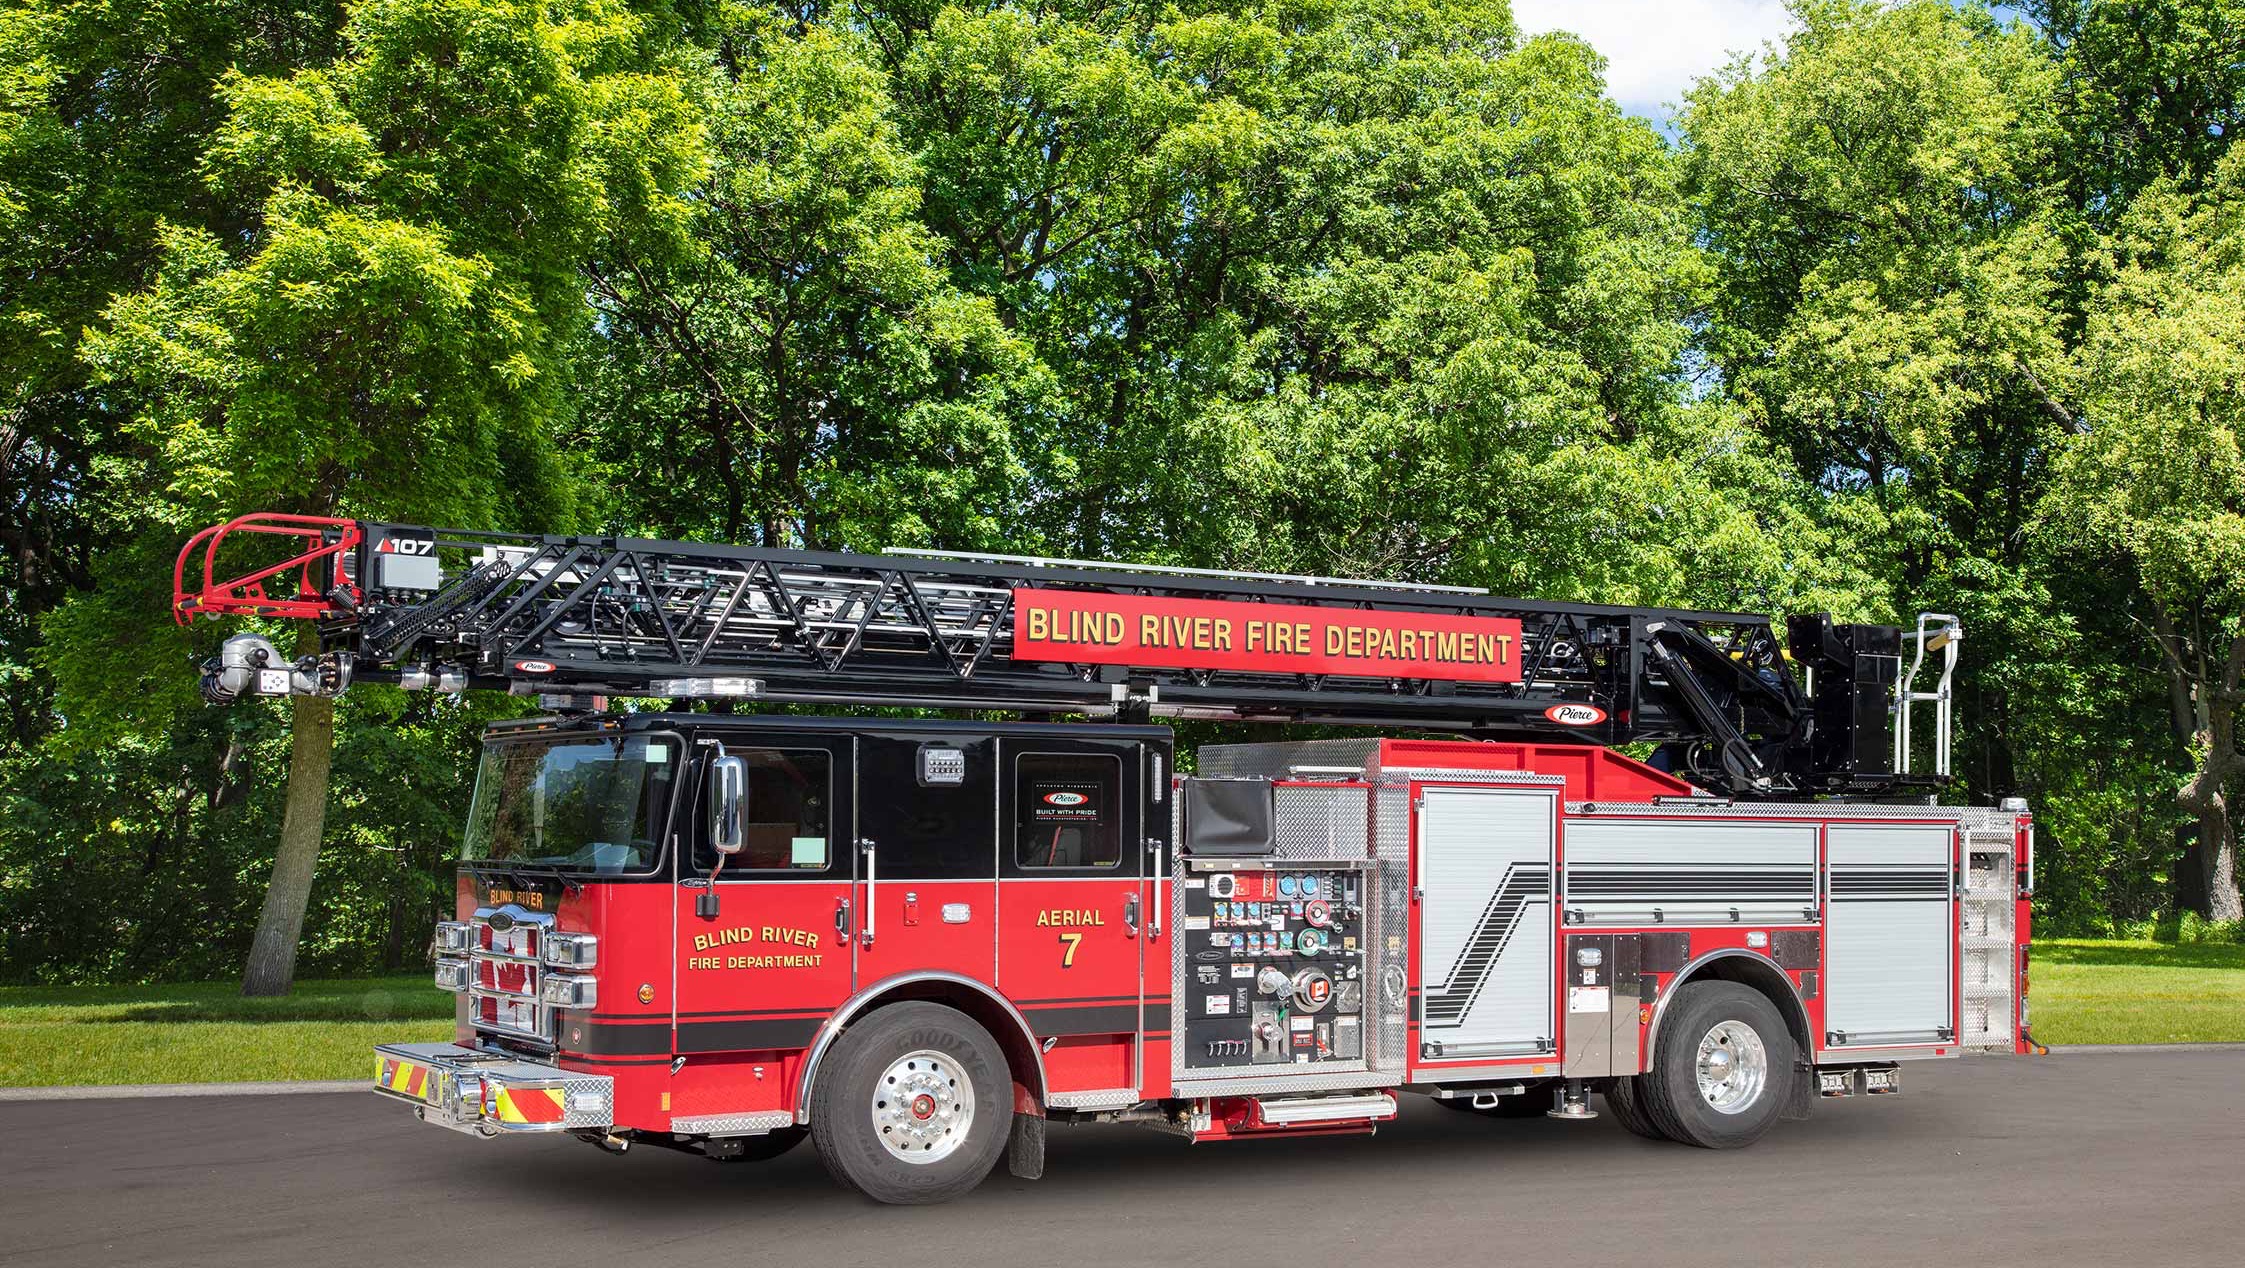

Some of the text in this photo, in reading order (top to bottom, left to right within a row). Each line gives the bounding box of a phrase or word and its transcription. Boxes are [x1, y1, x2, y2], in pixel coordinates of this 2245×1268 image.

[1027, 608, 1512, 665] BLIND RIVER FIRE DEPARTMENT
[1559, 706, 1592, 720] Pierce
[1053, 794, 1078, 803] Pierce
[490, 889, 543, 909] BLIND RIVER
[1036, 909, 1105, 927] AERIAL
[693, 926, 819, 952] BLIND RIVER
[1058, 933, 1082, 968] 7
[688, 954, 823, 970] FIRE DEPARTMENT
